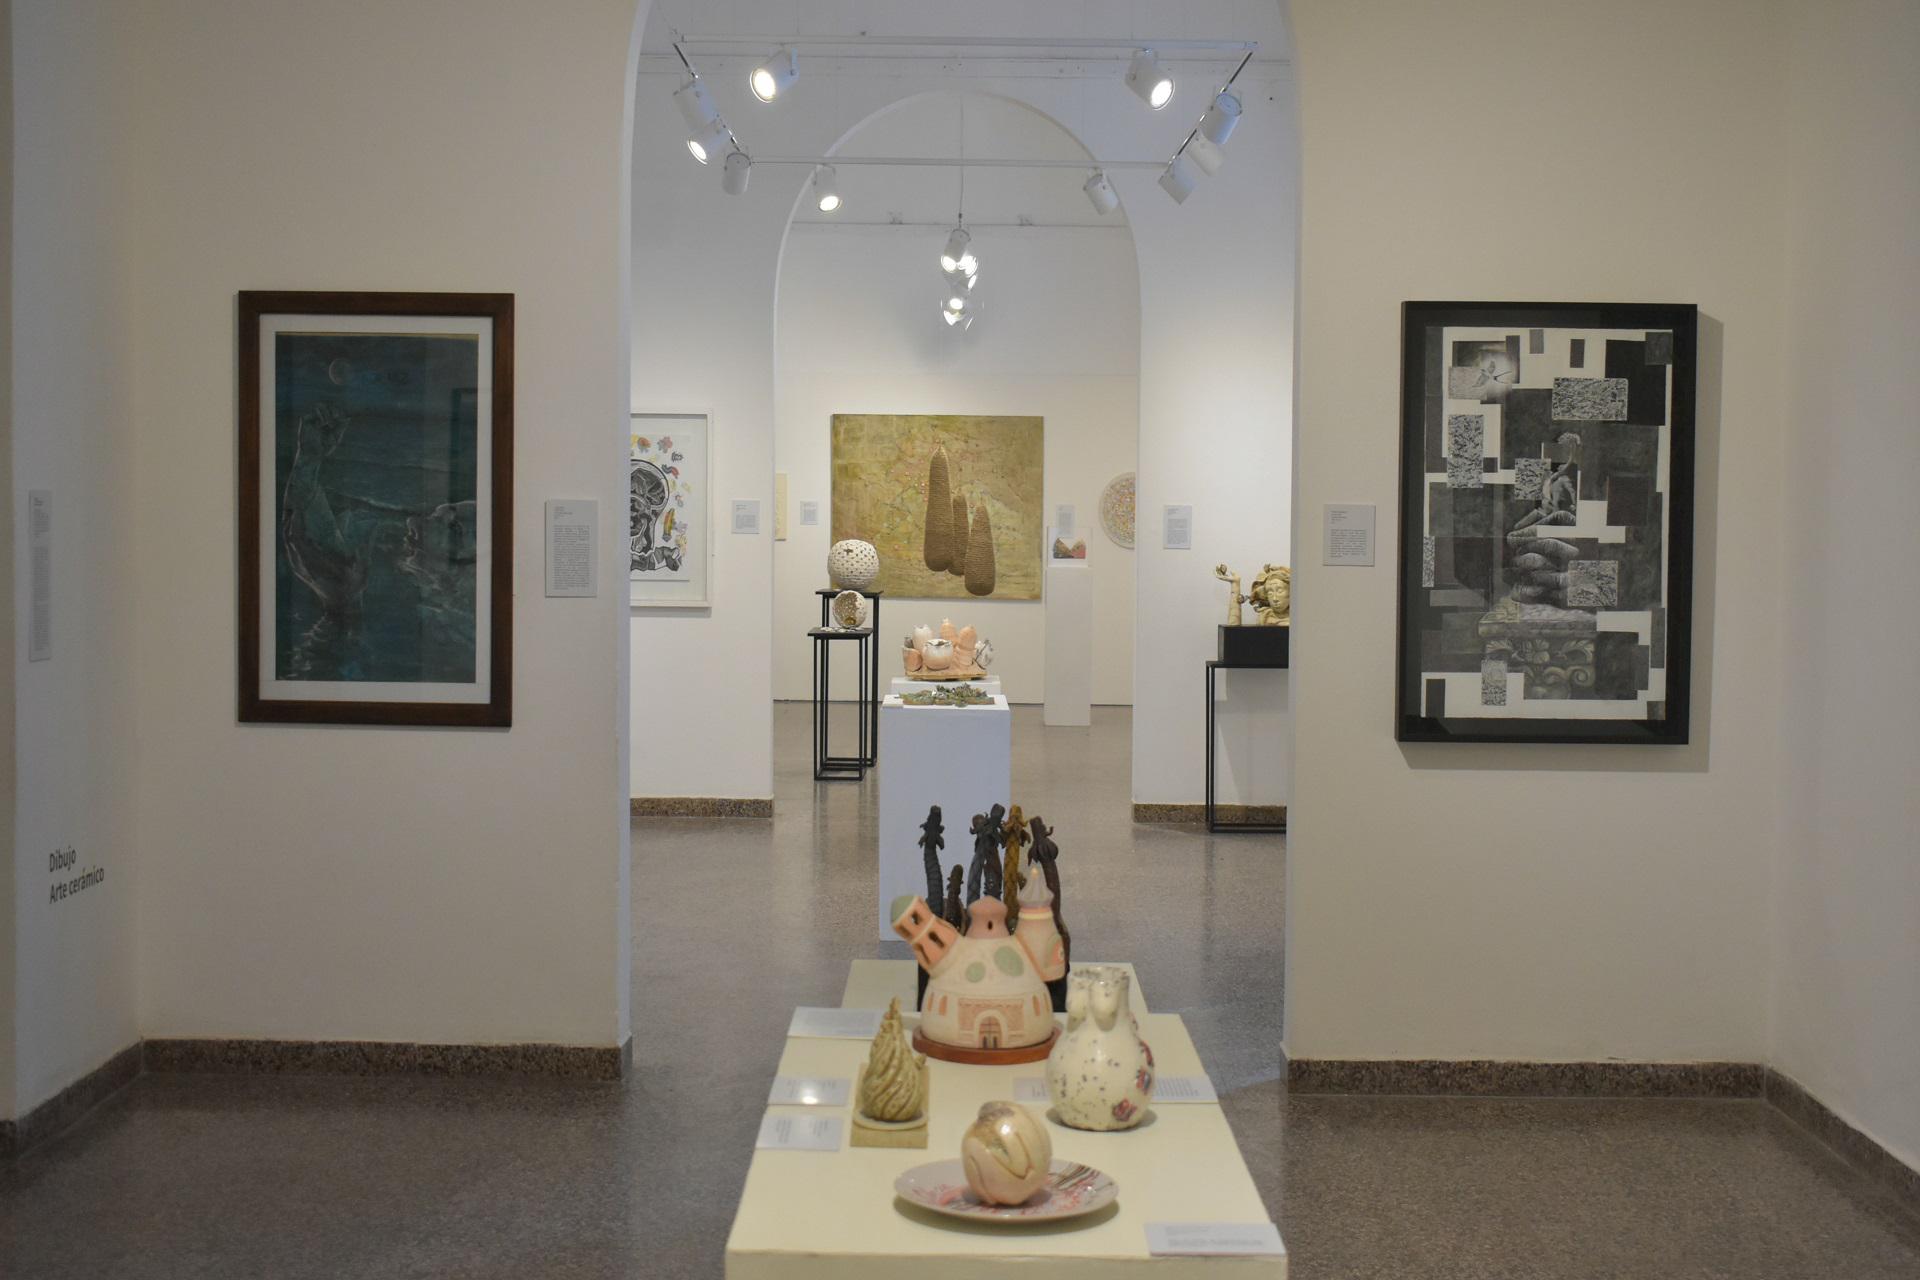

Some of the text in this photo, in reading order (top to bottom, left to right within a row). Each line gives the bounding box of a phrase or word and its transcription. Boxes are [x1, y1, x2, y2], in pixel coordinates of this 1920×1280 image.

[49, 845, 77, 872] Dibujo
[49, 865, 105, 904] Arte cerámico
